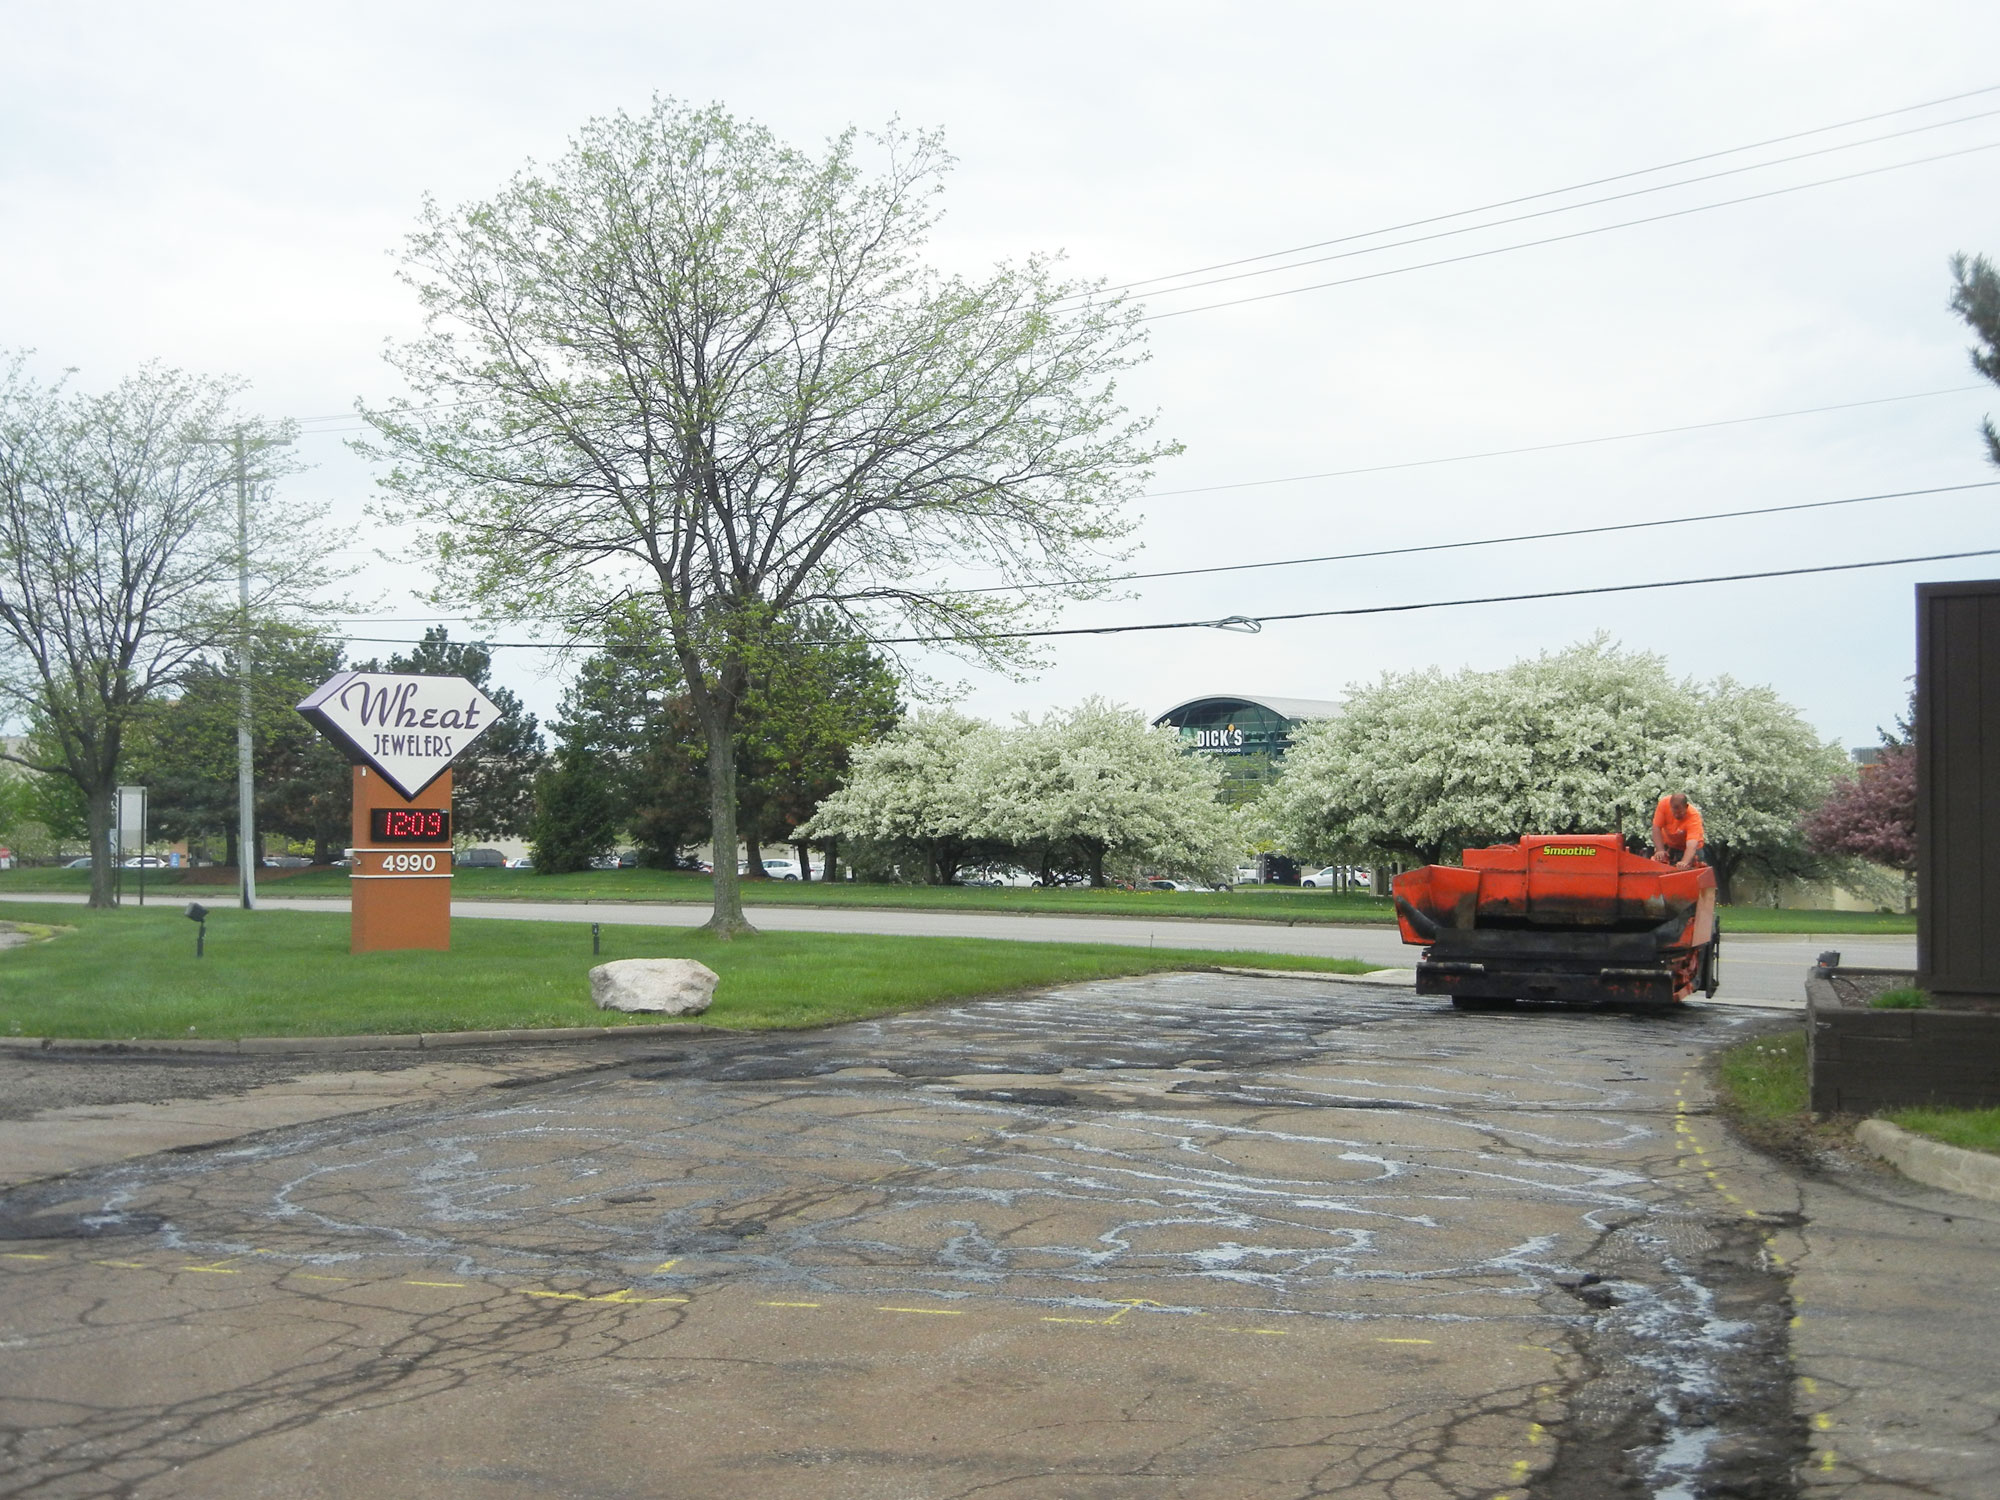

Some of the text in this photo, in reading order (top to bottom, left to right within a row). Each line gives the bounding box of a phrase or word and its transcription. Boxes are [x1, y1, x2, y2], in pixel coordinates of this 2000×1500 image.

[340, 681, 481, 730] Wheat
[373, 734, 453, 757] JEWELERS
[1197, 729, 1243, 747] DICK'S
[1543, 845, 1596, 856] Smoothie
[382, 854, 436, 872] 4990
